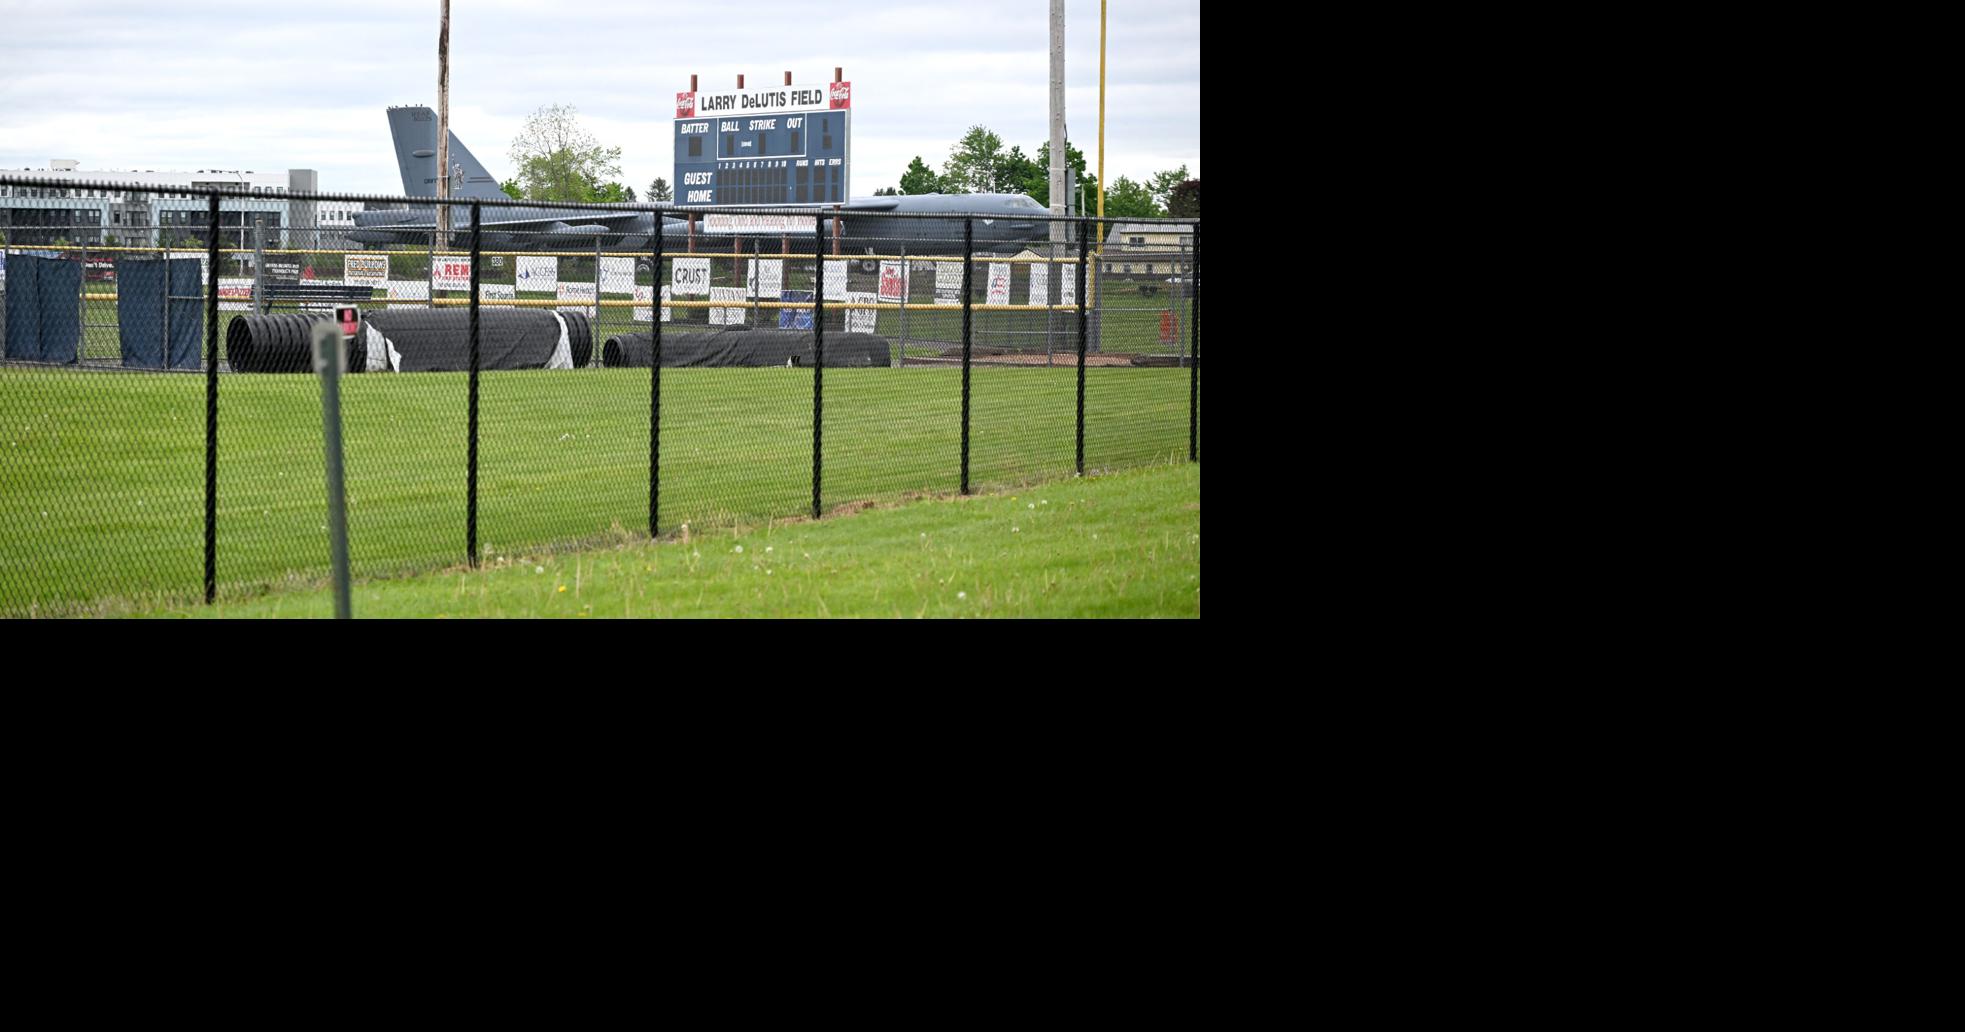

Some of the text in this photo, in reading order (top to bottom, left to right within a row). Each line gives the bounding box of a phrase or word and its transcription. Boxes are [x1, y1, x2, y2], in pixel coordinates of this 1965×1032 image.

[701, 89, 823, 111] LARRY DeLUTIS FIELD
[681, 123, 709, 134] BATTER
[721, 117, 803, 132] BALL STRIKE OUT
[775, 160, 779, 168] 9
[781, 160, 787, 168] 10
[684, 172, 713, 185] GUEST
[687, 190, 713, 203] HOME
[444, 264, 469, 275] REM
[674, 267, 707, 285] CRUST
